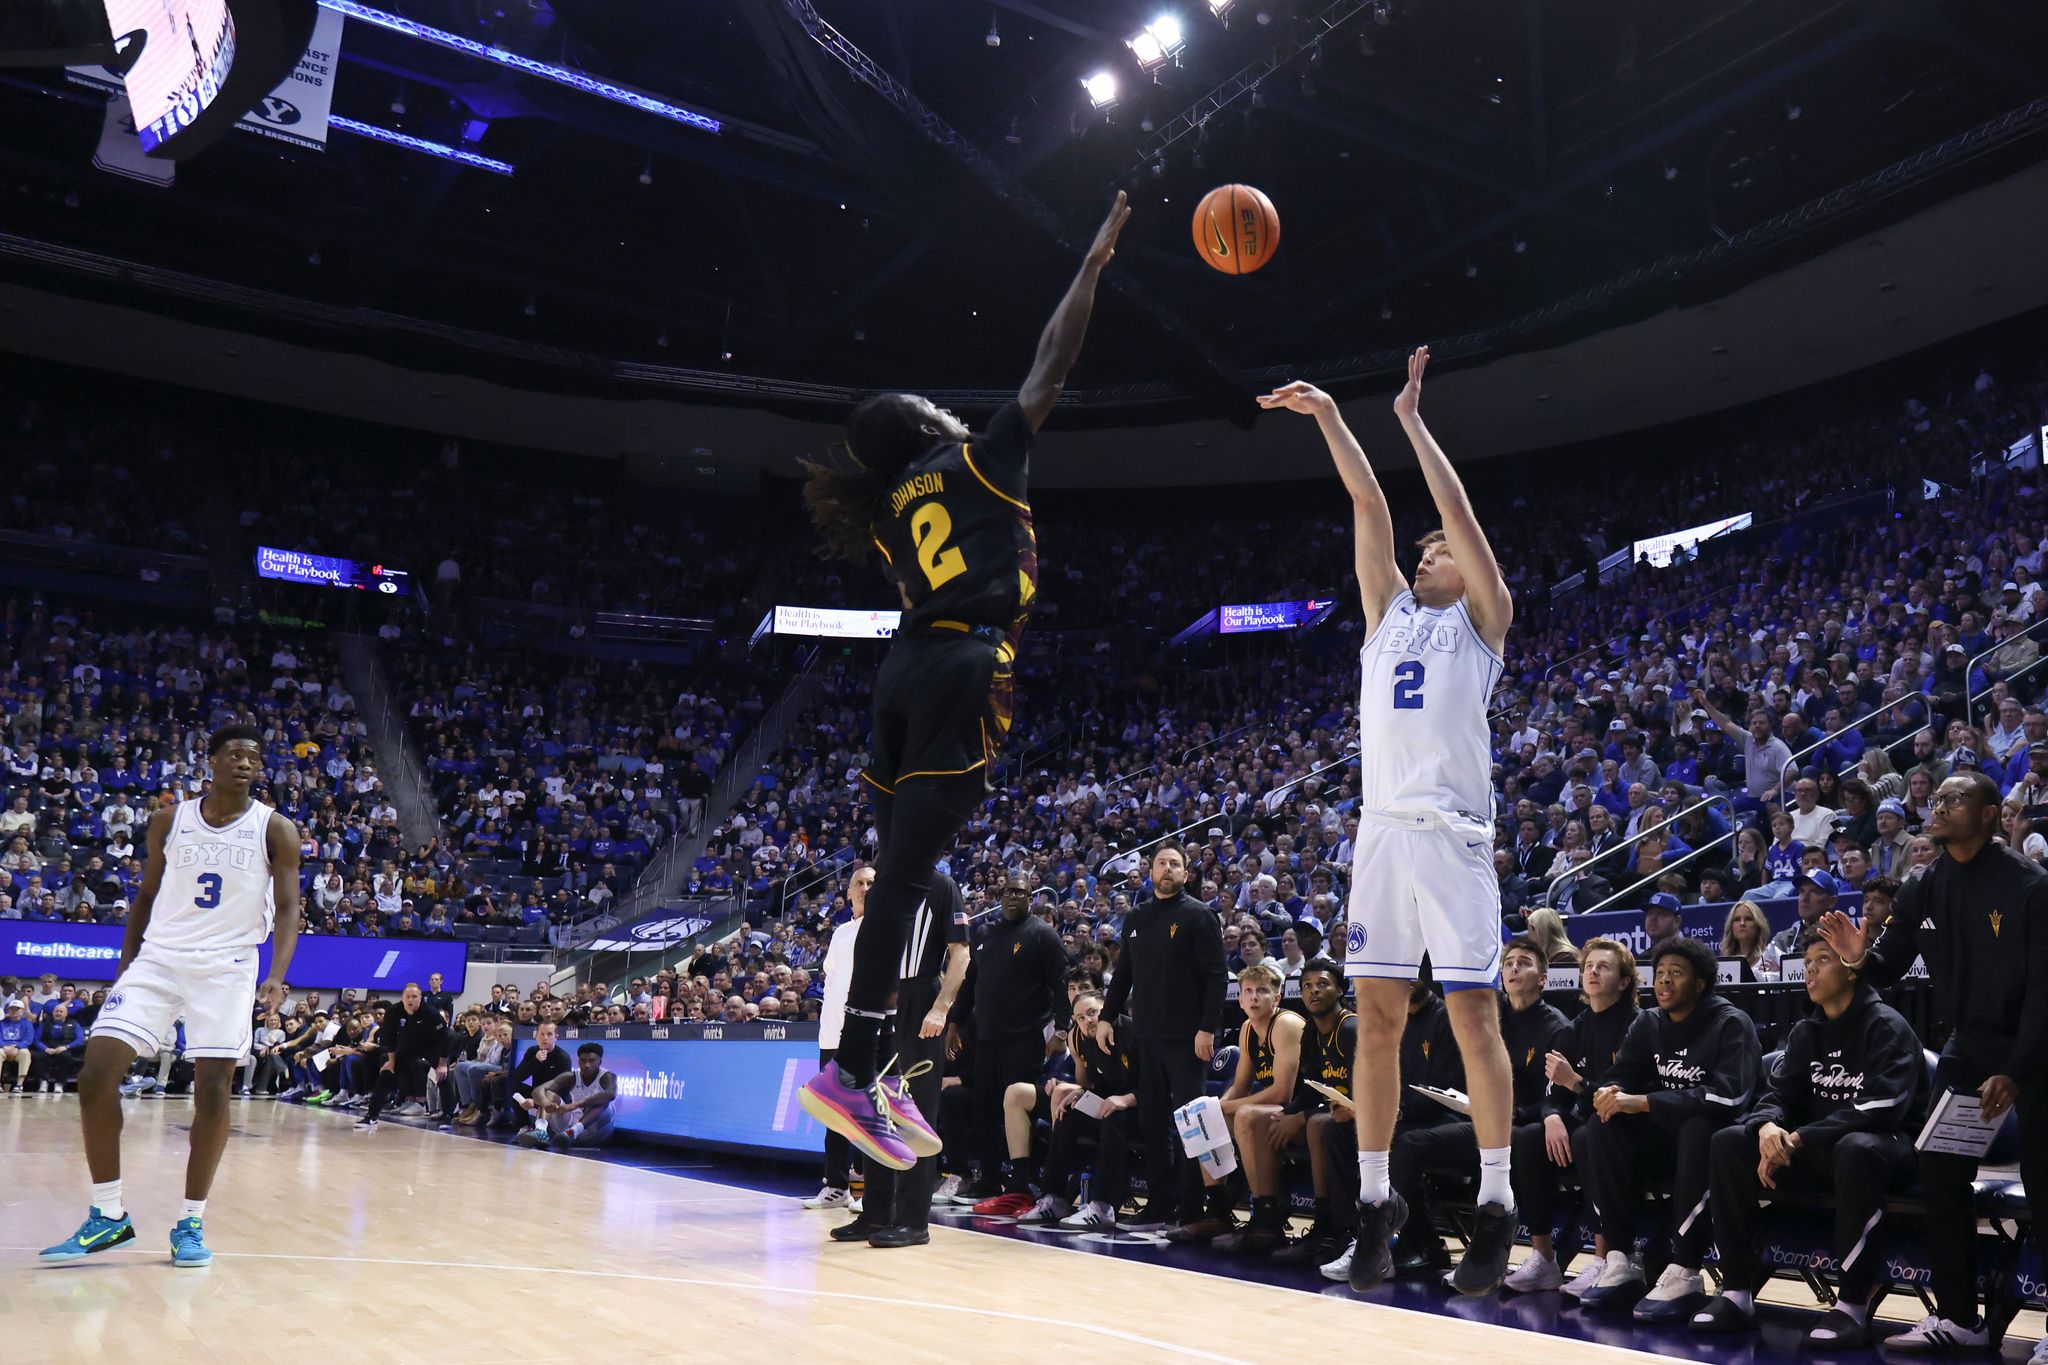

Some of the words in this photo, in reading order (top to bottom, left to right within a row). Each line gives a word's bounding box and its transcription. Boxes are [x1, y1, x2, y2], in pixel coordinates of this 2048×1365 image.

[1241, 208, 1256, 256] ELITE
[891, 472, 944, 518] JOHNSON
[911, 502, 968, 591] 2
[262, 549, 301, 564] Health
[304, 555, 313, 567] is
[261, 560, 286, 572] Our
[288, 564, 341, 581] Playbook
[779, 608, 811, 618] Health
[813, 610, 821, 618] is
[1224, 607, 1254, 617] Health
[1255, 606, 1263, 616] is
[1224, 616, 1243, 626] Our
[1244, 614, 1285, 626] Playbook
[779, 618, 798, 628] Our
[800, 619, 844, 631] Playbook
[1382, 624, 1458, 656] BYU
[1393, 660, 1425, 709] 2
[175, 842, 255, 871] BYU
[1773, 858, 1795, 880] 24
[194, 873, 223, 909] 3
[1691, 925, 1714, 937] pest
[16, 941, 114, 959] Healthcare
[616, 1075, 644, 1097] areers
[644, 1070, 668, 1099] built
[668, 1071, 686, 1100] for
